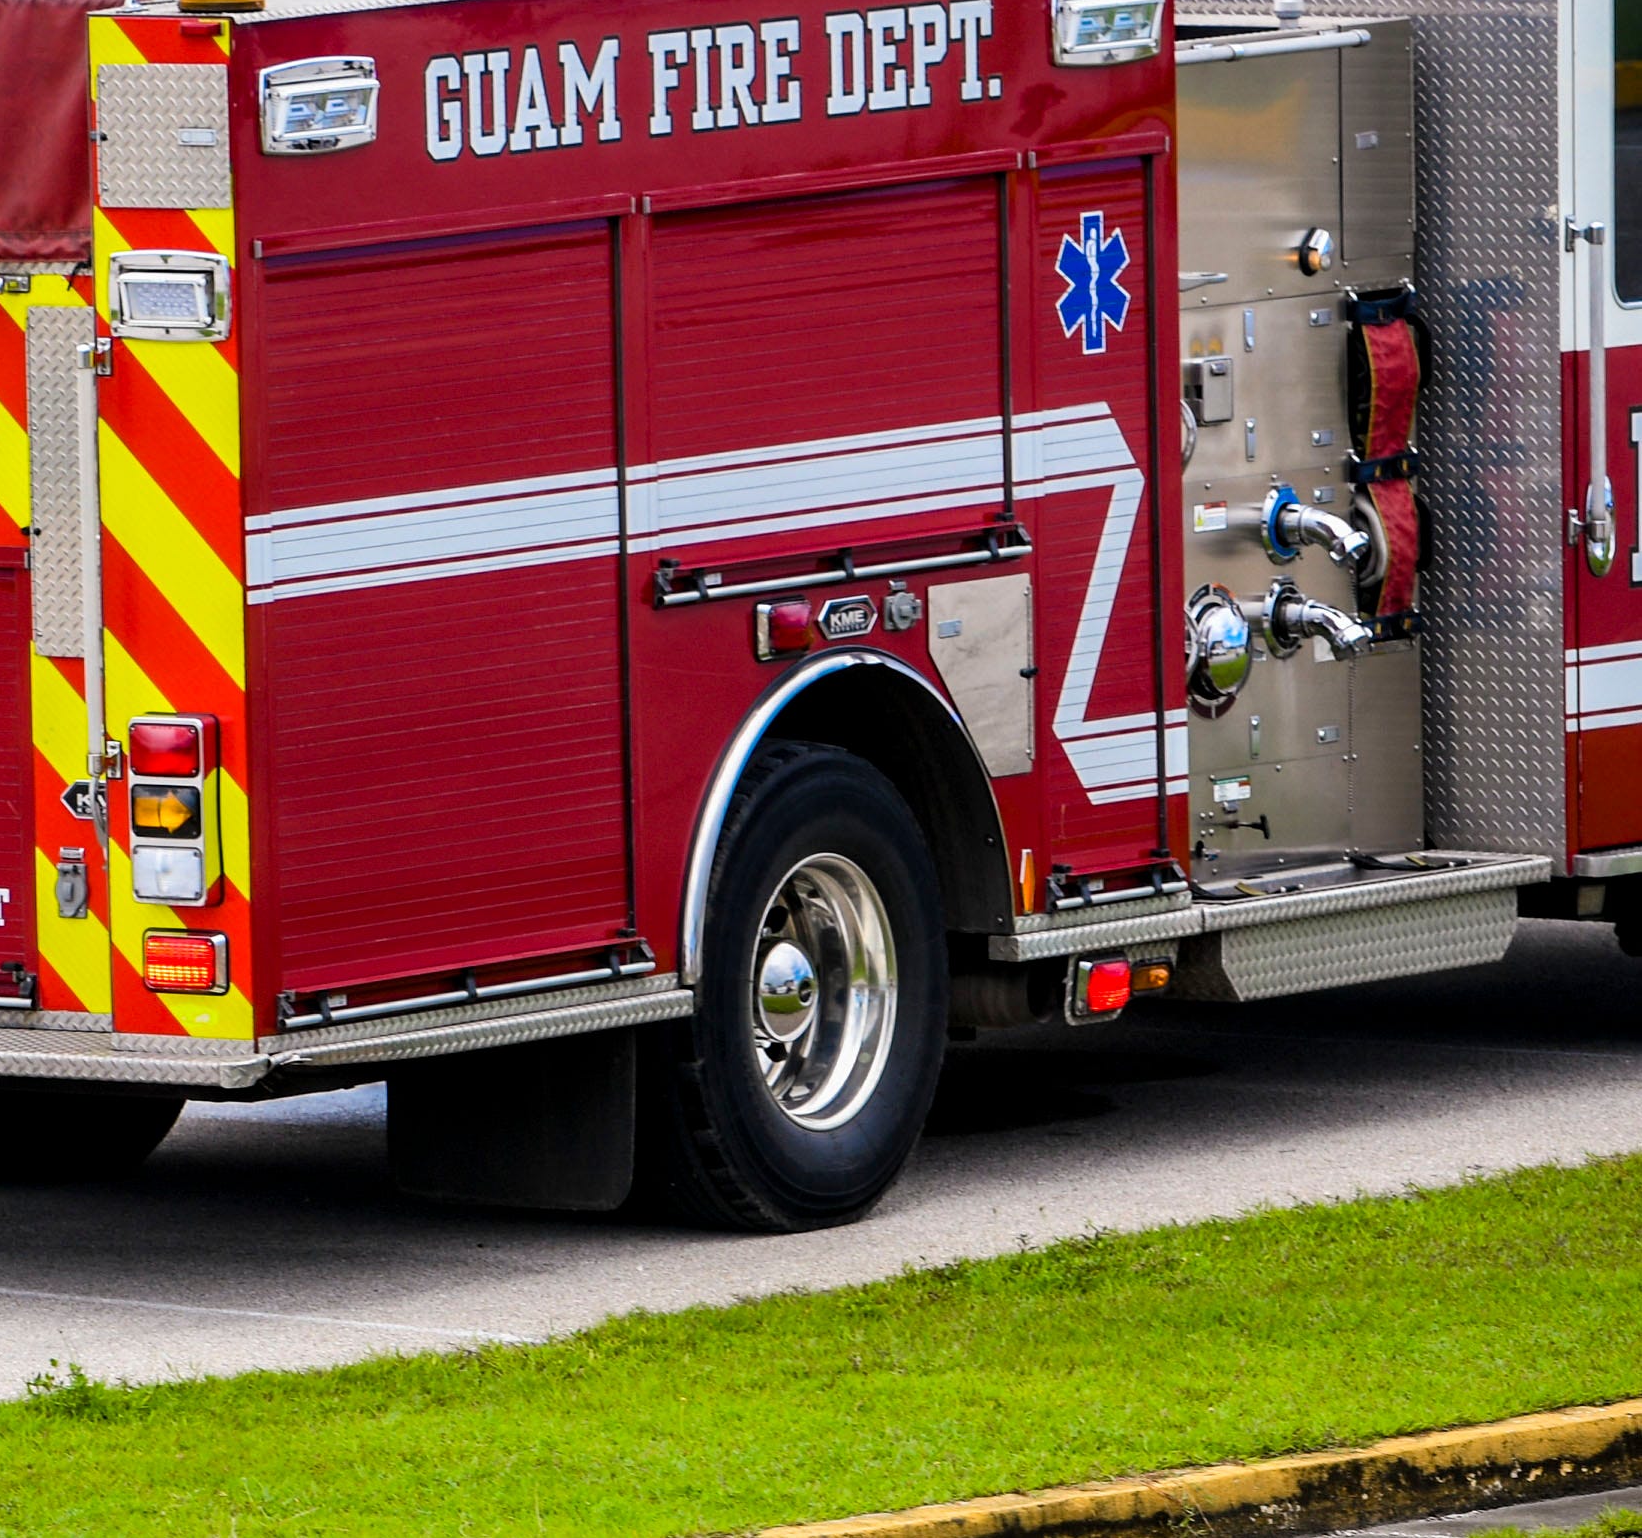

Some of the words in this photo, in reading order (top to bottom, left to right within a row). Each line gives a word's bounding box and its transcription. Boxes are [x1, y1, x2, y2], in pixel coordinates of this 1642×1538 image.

[425, 35, 621, 163] GUAM
[647, 17, 802, 137] FIRE
[829, 609, 865, 628] KME
